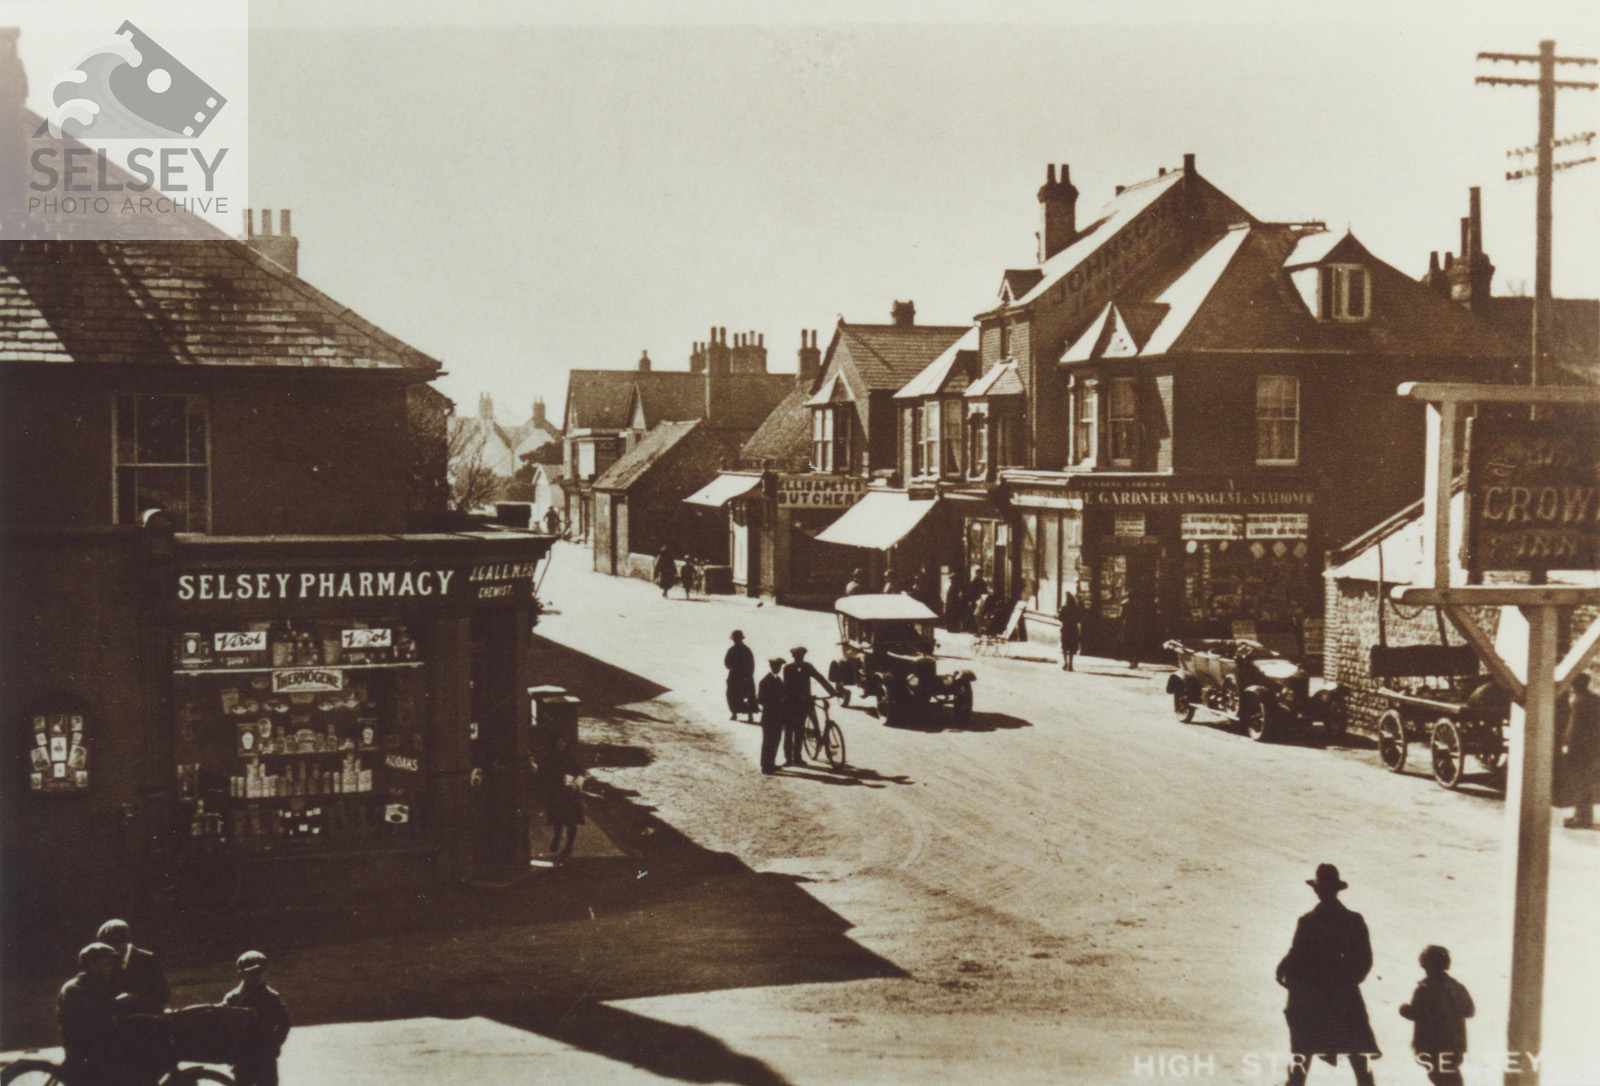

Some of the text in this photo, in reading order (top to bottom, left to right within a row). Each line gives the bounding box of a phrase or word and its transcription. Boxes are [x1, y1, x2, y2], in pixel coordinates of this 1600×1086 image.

[1098, 491, 1169, 505] GARDNER
[1481, 486, 1600, 524] CROW
[178, 569, 454, 600] SELSEY PHARMACY
[217, 632, 262, 650] Virol
[274, 669, 340, 690] THERMOGENE
